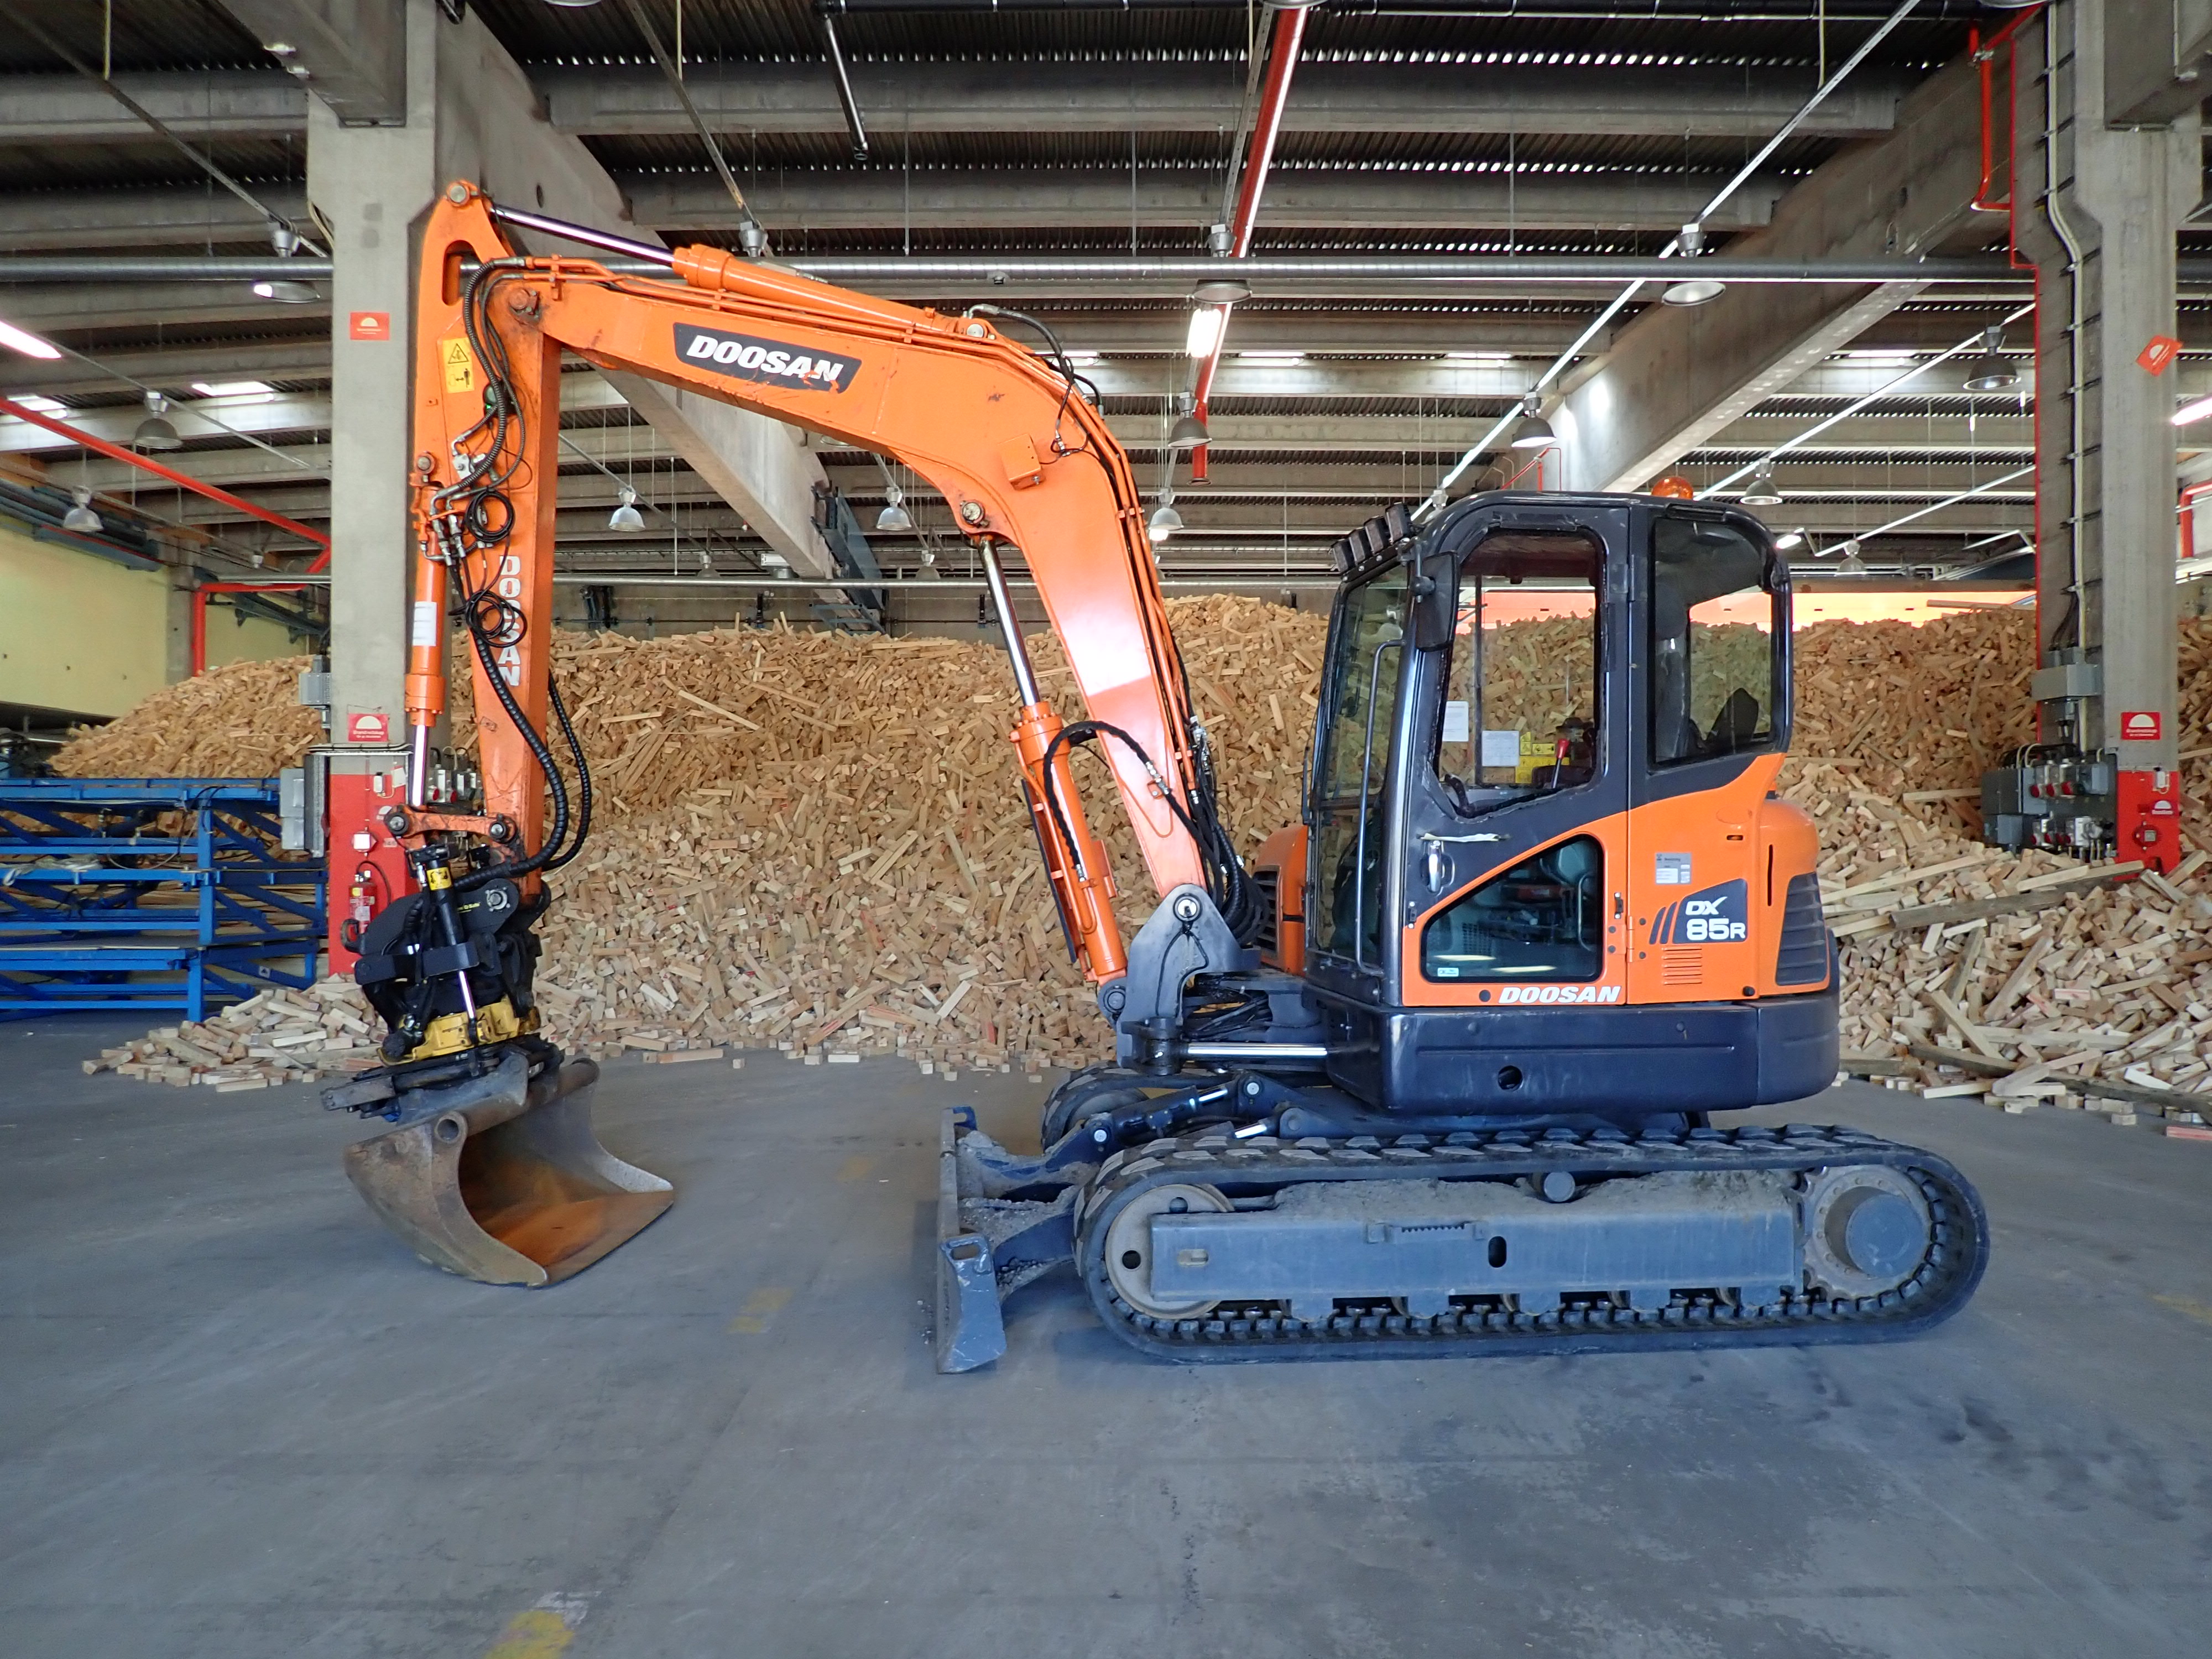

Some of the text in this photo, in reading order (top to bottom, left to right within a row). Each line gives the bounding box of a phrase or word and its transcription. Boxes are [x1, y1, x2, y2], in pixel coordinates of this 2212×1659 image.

[686, 335, 844, 382] DOOSAN
[1685, 896, 1728, 915] DX
[1686, 918, 1746, 941] 85R
[1498, 986, 1621, 1004] DOOSAN
